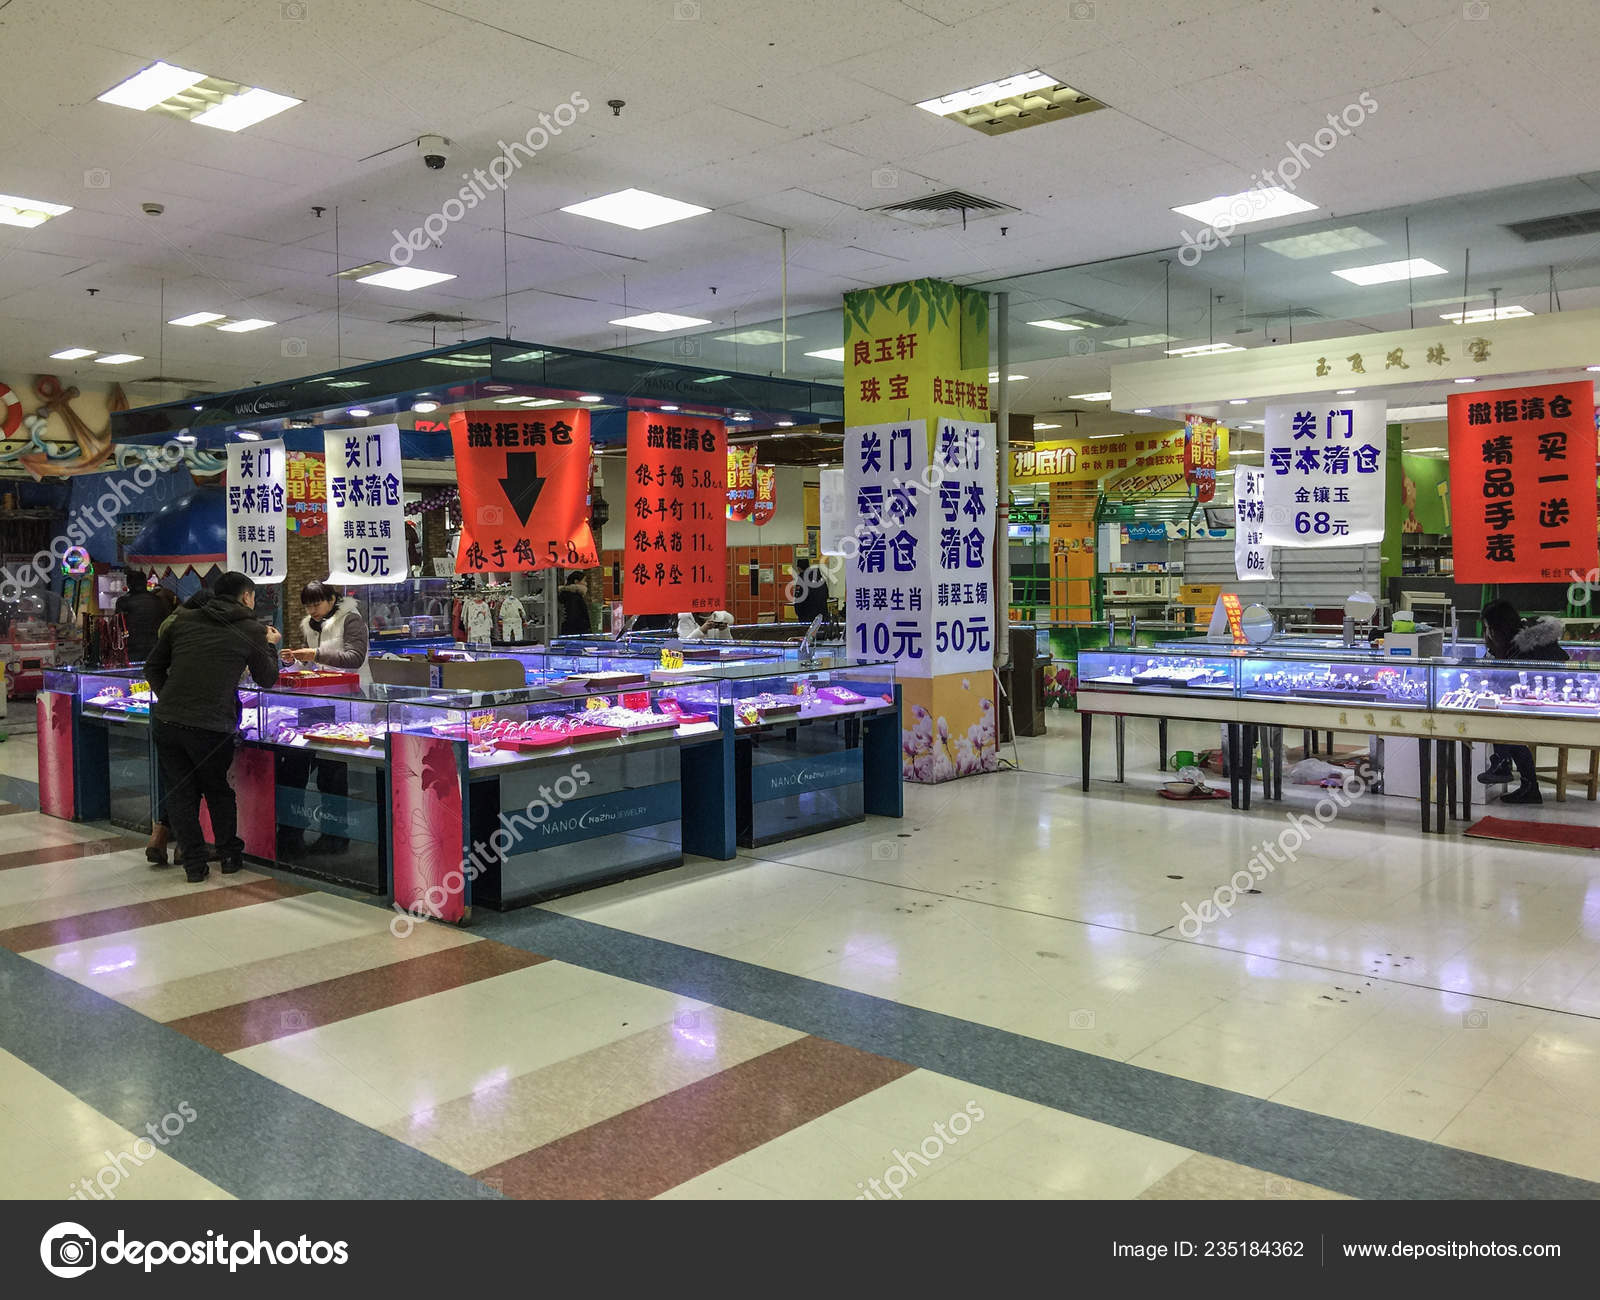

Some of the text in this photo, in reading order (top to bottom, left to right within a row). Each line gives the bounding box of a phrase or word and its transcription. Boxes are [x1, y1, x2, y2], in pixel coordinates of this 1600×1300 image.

[854, 333, 918, 366] 良玉轩
[860, 374, 909, 403] 珠宝
[933, 376, 988, 410] 良玉轩珠宝
[1292, 409, 1354, 440] 关门
[1468, 394, 1573, 426] 撤柜清仓
[467, 421, 573, 448] 撤柜清仓
[647, 424, 716, 453] 撤柜清仓
[941, 425, 980, 470] 关门
[240, 448, 271, 478] 关门
[344, 434, 382, 468] 关门
[861, 428, 912, 474] 关门
[1014, 447, 1077, 477] 抄底价
[1270, 444, 1381, 475] 亏本清仓
[229, 483, 284, 514] 亏本清仓
[331, 473, 400, 507] 亏本清仓
[857, 483, 918, 526] 亏本
[939, 480, 986, 522] 亏本
[1294, 486, 1351, 504] 金镶玉
[1482, 435, 1516, 563] 精品手表
[1537, 431, 1572, 551] 买一送一
[634, 497, 684, 522] 银耳钉
[1238, 499, 1264, 522] 亏本清
[1294, 511, 1350, 536] 68元
[238, 525, 276, 543] 翡翠生肖
[344, 520, 391, 539] 翡翠玉镯
[633, 530, 682, 555] 银戒指
[241, 549, 274, 577] 10元
[346, 546, 390, 577] 50元
[857, 530, 918, 573] 清仓
[940, 527, 985, 569] 清仓
[1247, 551, 1264, 570] 68元
[632, 563, 682, 588] 银吊坠
[855, 587, 922, 611] 翡翠生肖
[938, 583, 988, 605] 翡翠玉镯
[855, 621, 923, 659] 10元
[936, 616, 990, 653] 50元
[770, 774, 796, 788] NANO
[541, 819, 578, 836] NANO
